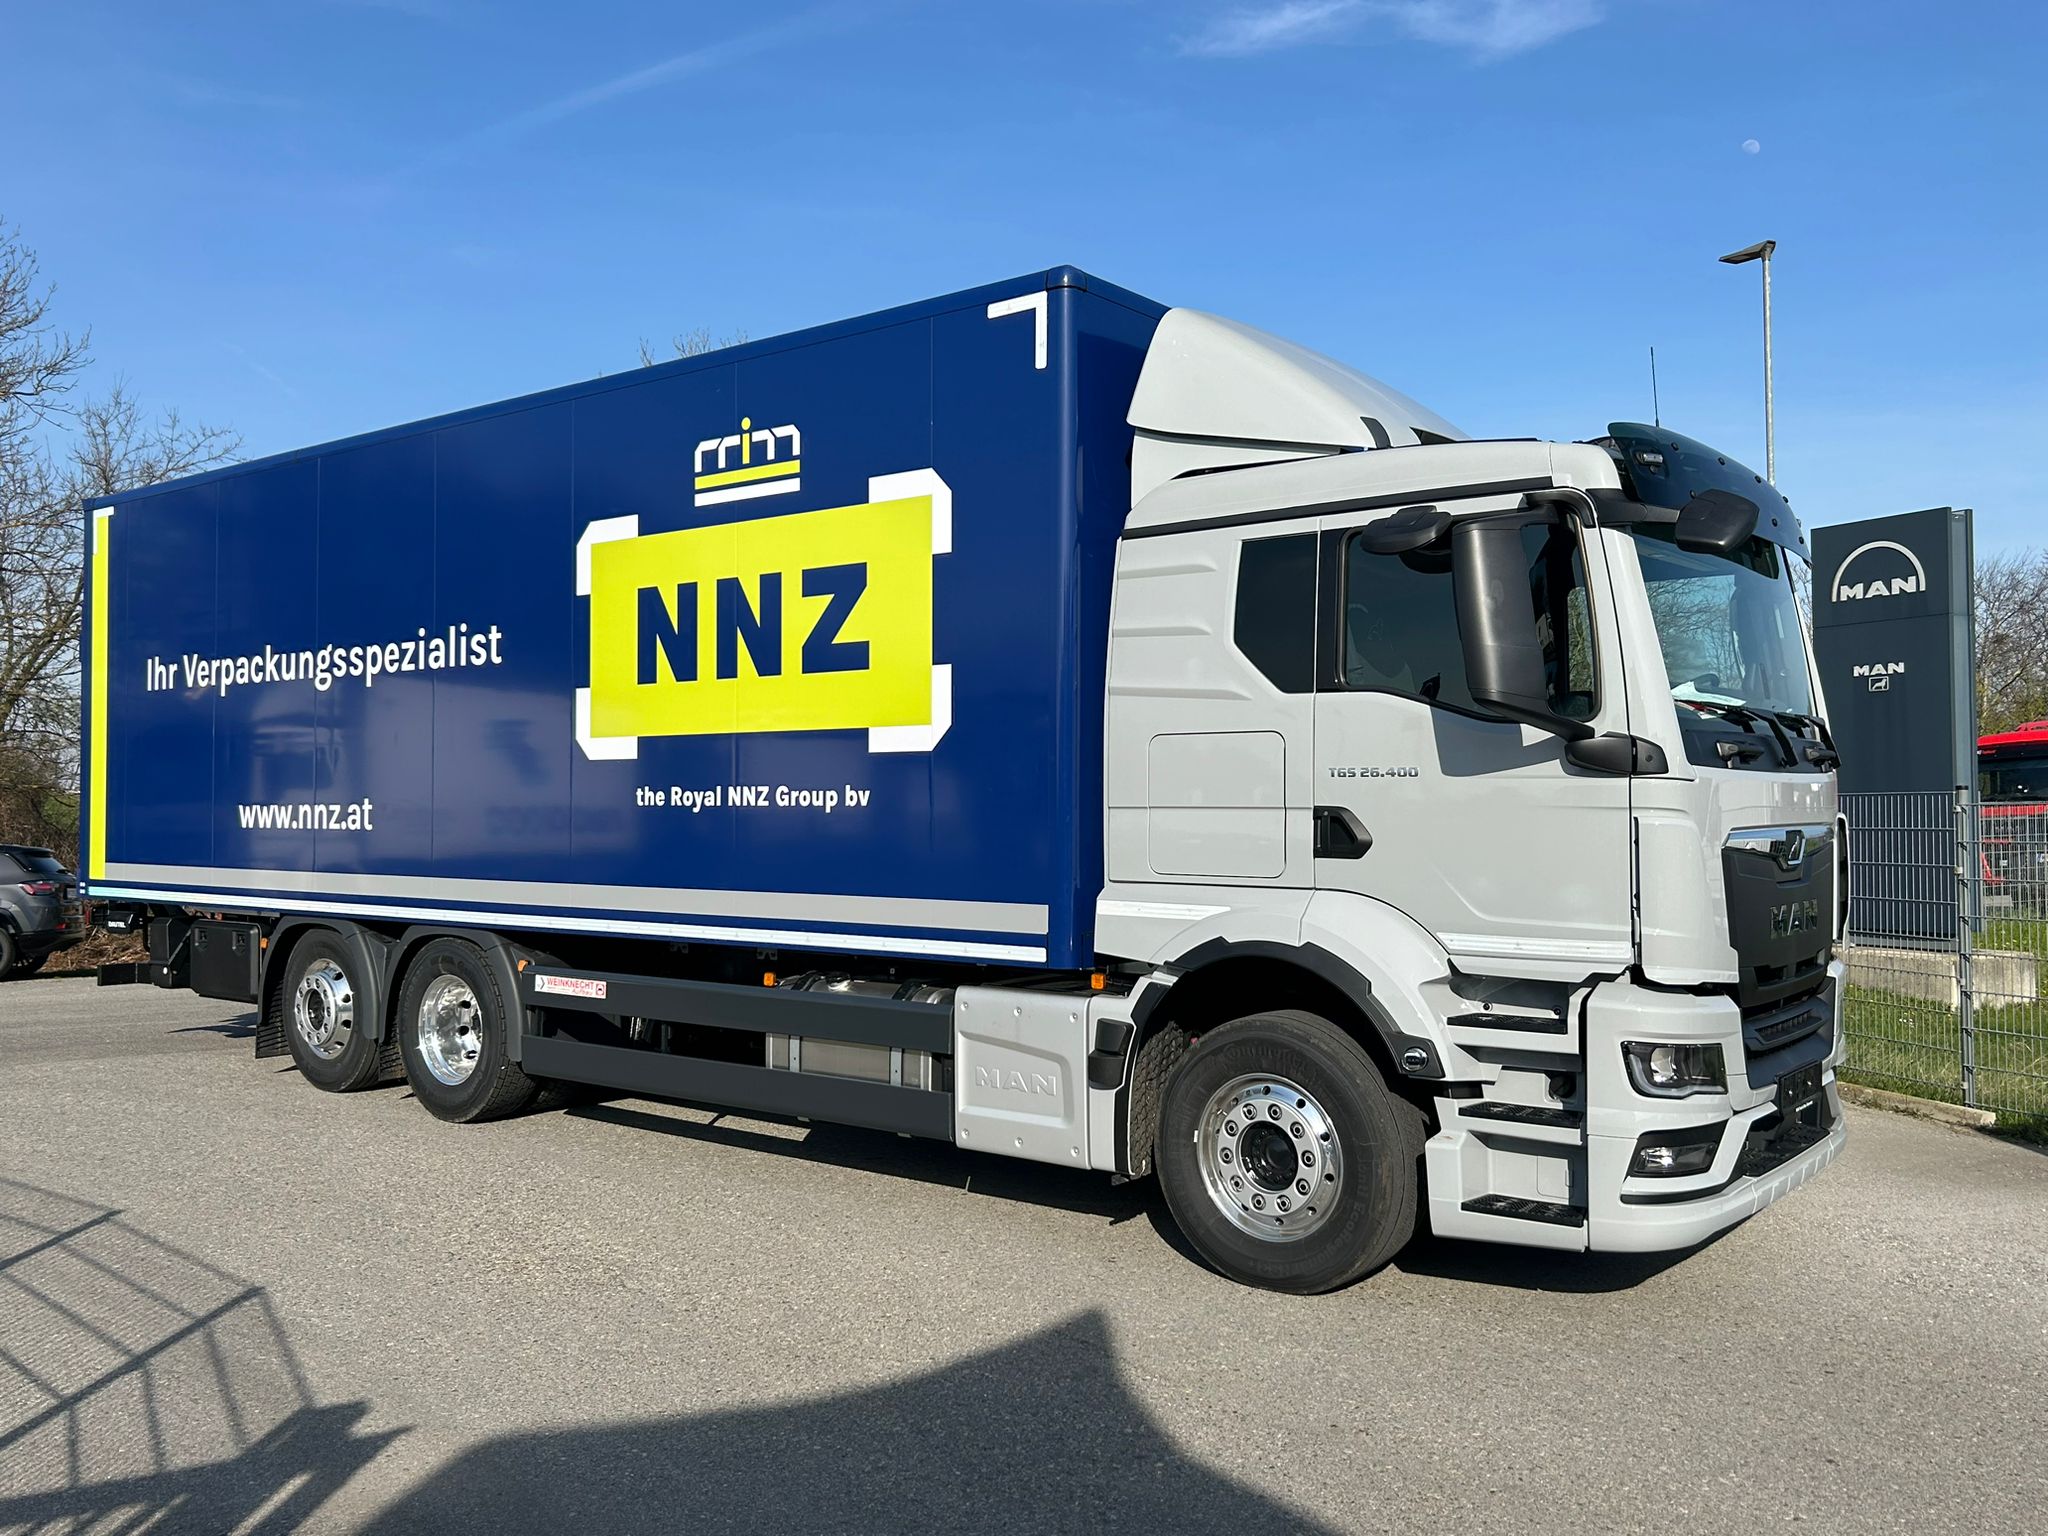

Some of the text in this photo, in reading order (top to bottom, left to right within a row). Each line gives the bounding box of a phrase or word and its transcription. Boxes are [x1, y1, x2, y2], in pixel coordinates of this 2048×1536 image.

[1840, 575, 1917, 602] MAN
[637, 562, 870, 686] NNZ
[147, 622, 503, 697] Ihr Verpackungsspezialist
[1853, 661, 1905, 677] MAN
[1328, 767, 1419, 778] TGS 26.400
[635, 784, 870, 813] the Royal NNZ Group bv
[238, 797, 373, 831] www.nnz.at
[1769, 898, 1818, 939] MAN
[547, 977, 594, 990] WEINKNECHT
[975, 1065, 1057, 1097] MAN
